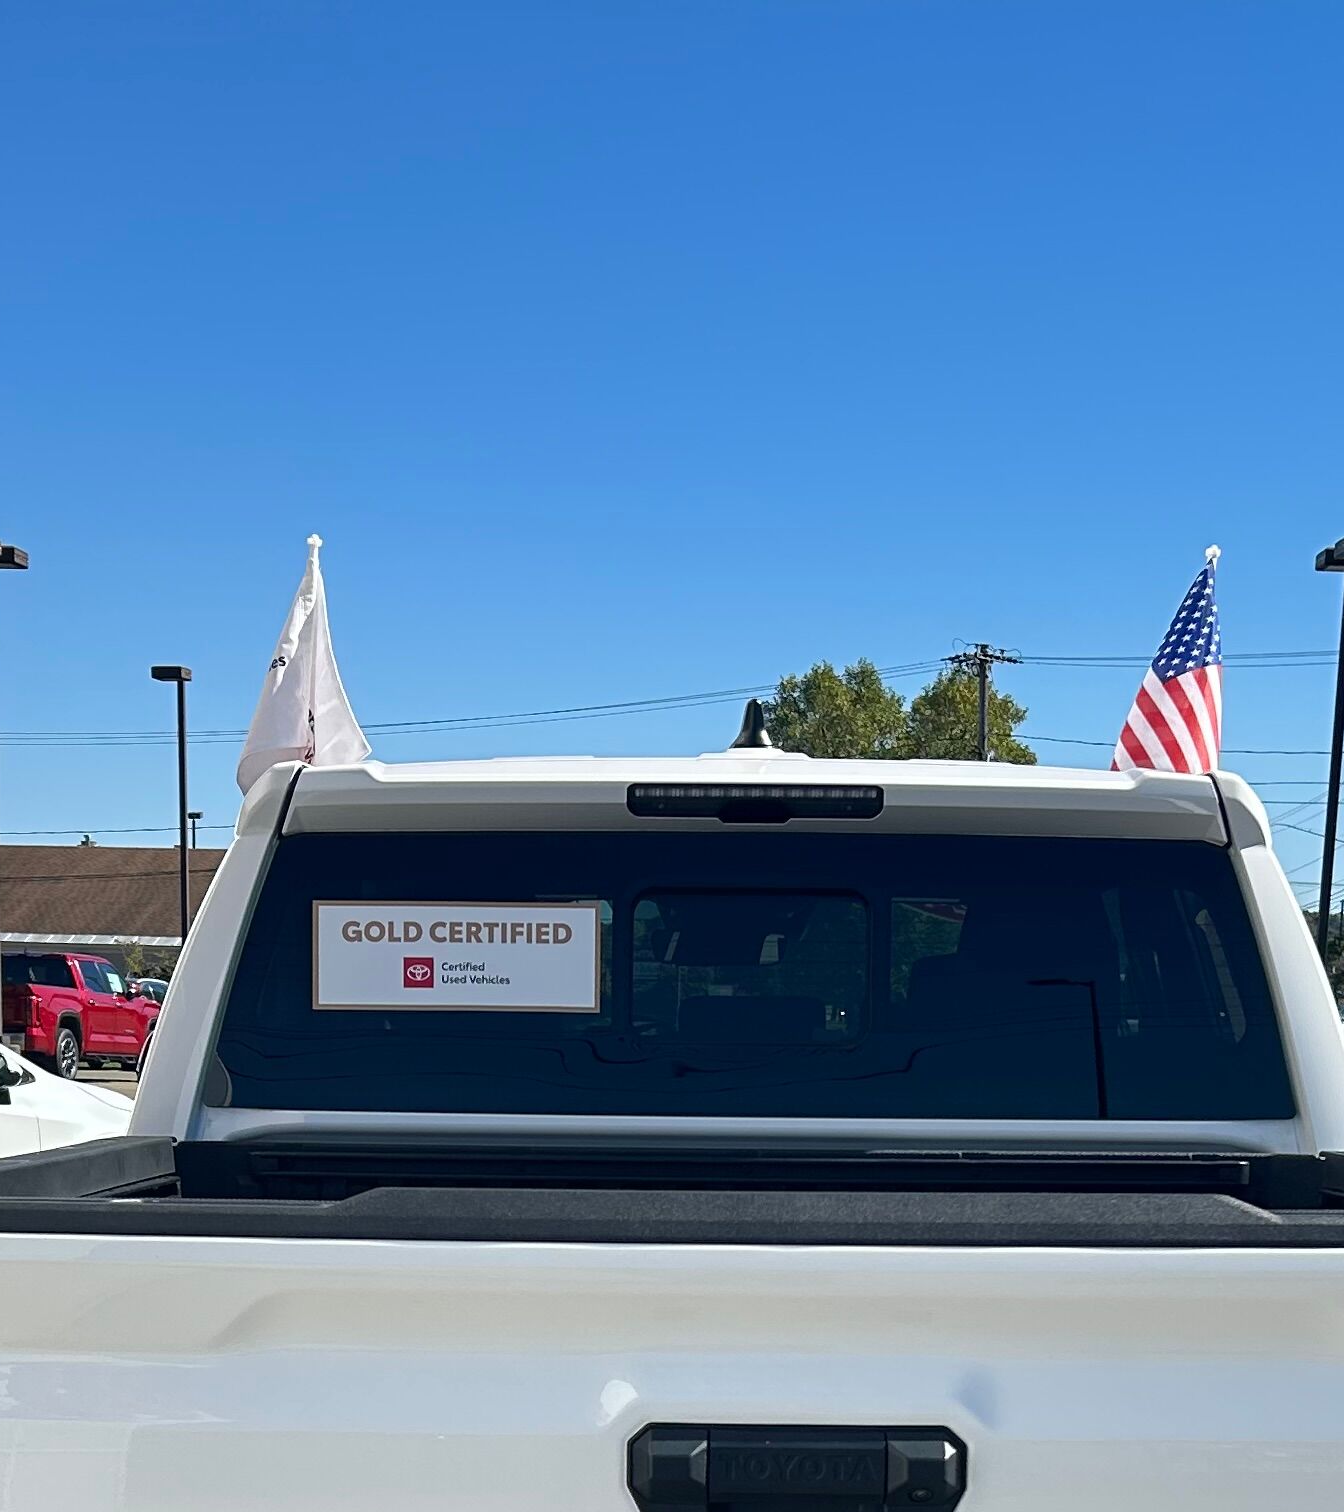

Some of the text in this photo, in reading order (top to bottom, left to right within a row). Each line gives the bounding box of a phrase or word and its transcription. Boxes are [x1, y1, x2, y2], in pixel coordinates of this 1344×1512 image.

[342, 920, 573, 944] GOLD CERTIFIED
[441, 962, 485, 972] Certified
[441, 974, 510, 985] Used Vehicles
[718, 1454, 877, 1481] TOYOTA
